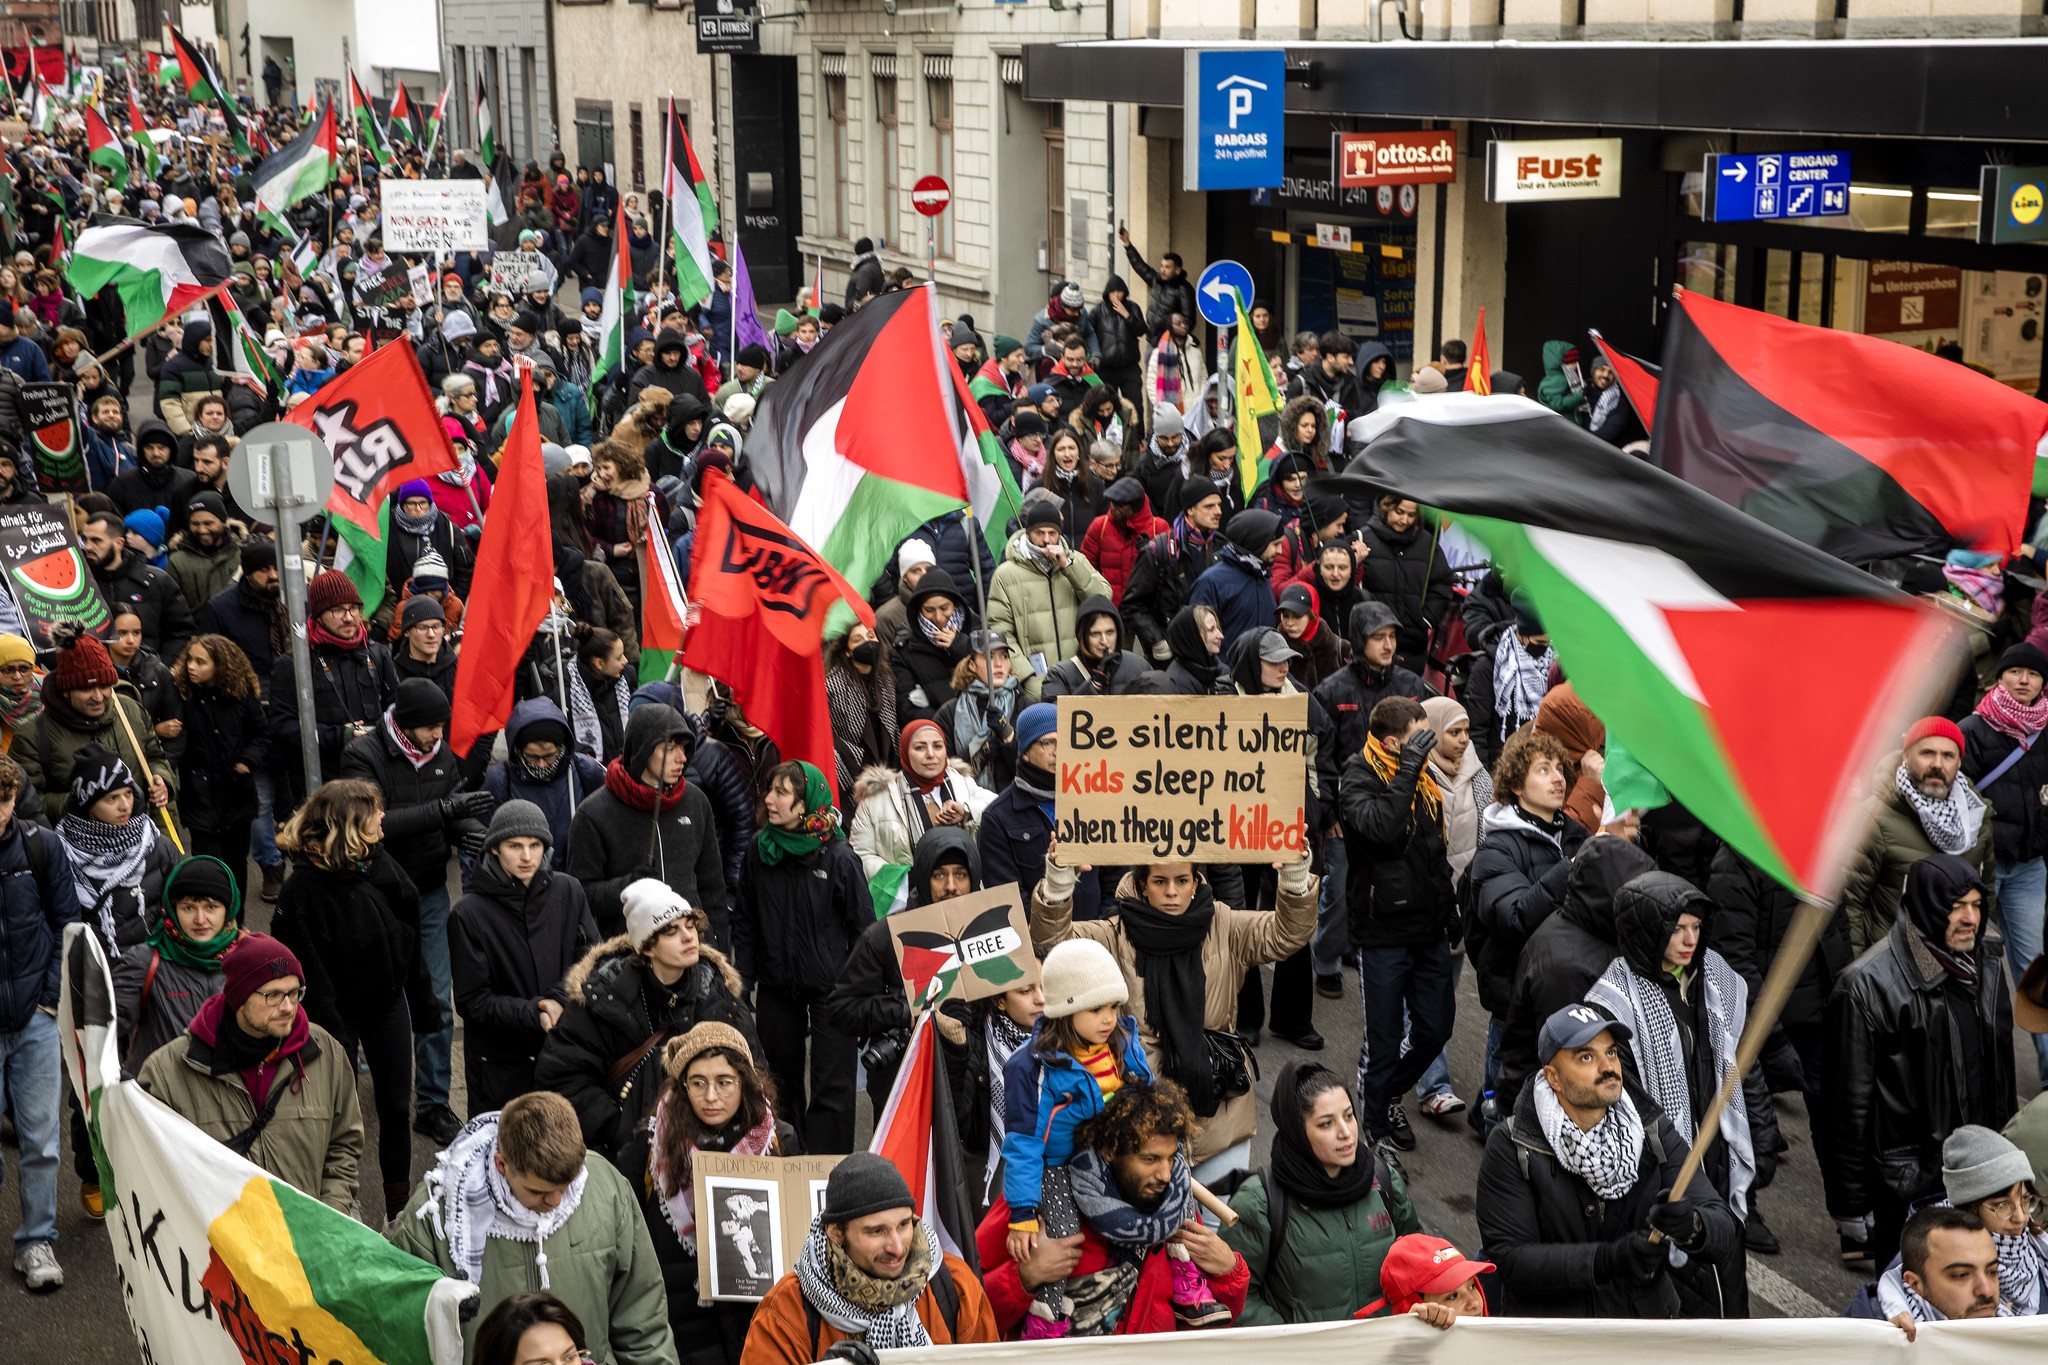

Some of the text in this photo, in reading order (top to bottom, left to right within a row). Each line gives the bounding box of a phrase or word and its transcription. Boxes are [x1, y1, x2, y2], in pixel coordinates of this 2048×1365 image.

[721, 21, 750, 34] FITNESS
[1229, 88, 1252, 129] P
[1214, 133, 1268, 147] RABGASS
[1233, 148, 1267, 161] geöffnet
[1377, 139, 1453, 165] ottos.ch
[1789, 154, 1838, 168] EINGANG
[1518, 153, 1602, 180] Fust
[1788, 169, 1829, 181] CENTER
[1279, 177, 1335, 201] EINFAHRT
[360, 271, 386, 293] FREE
[355, 305, 389, 319] STP
[28, 511, 43, 523] für
[21, 521, 64, 537] Palästina
[24, 592, 52, 610] Gegen
[29, 605, 47, 618] und
[1070, 710, 1308, 756] Be silent when
[1061, 759, 1266, 806] Kids sleep not
[1055, 803, 1306, 857] when they get killed
[967, 935, 1005, 959] FREE
[1568, 1006, 1599, 1024] W
[697, 1156, 709, 1174] IT
[715, 1156, 746, 1174] DIDN'T
[750, 1160, 776, 1174] START
[783, 1161, 802, 1173] ON
[805, 1161, 824, 1174] THE
